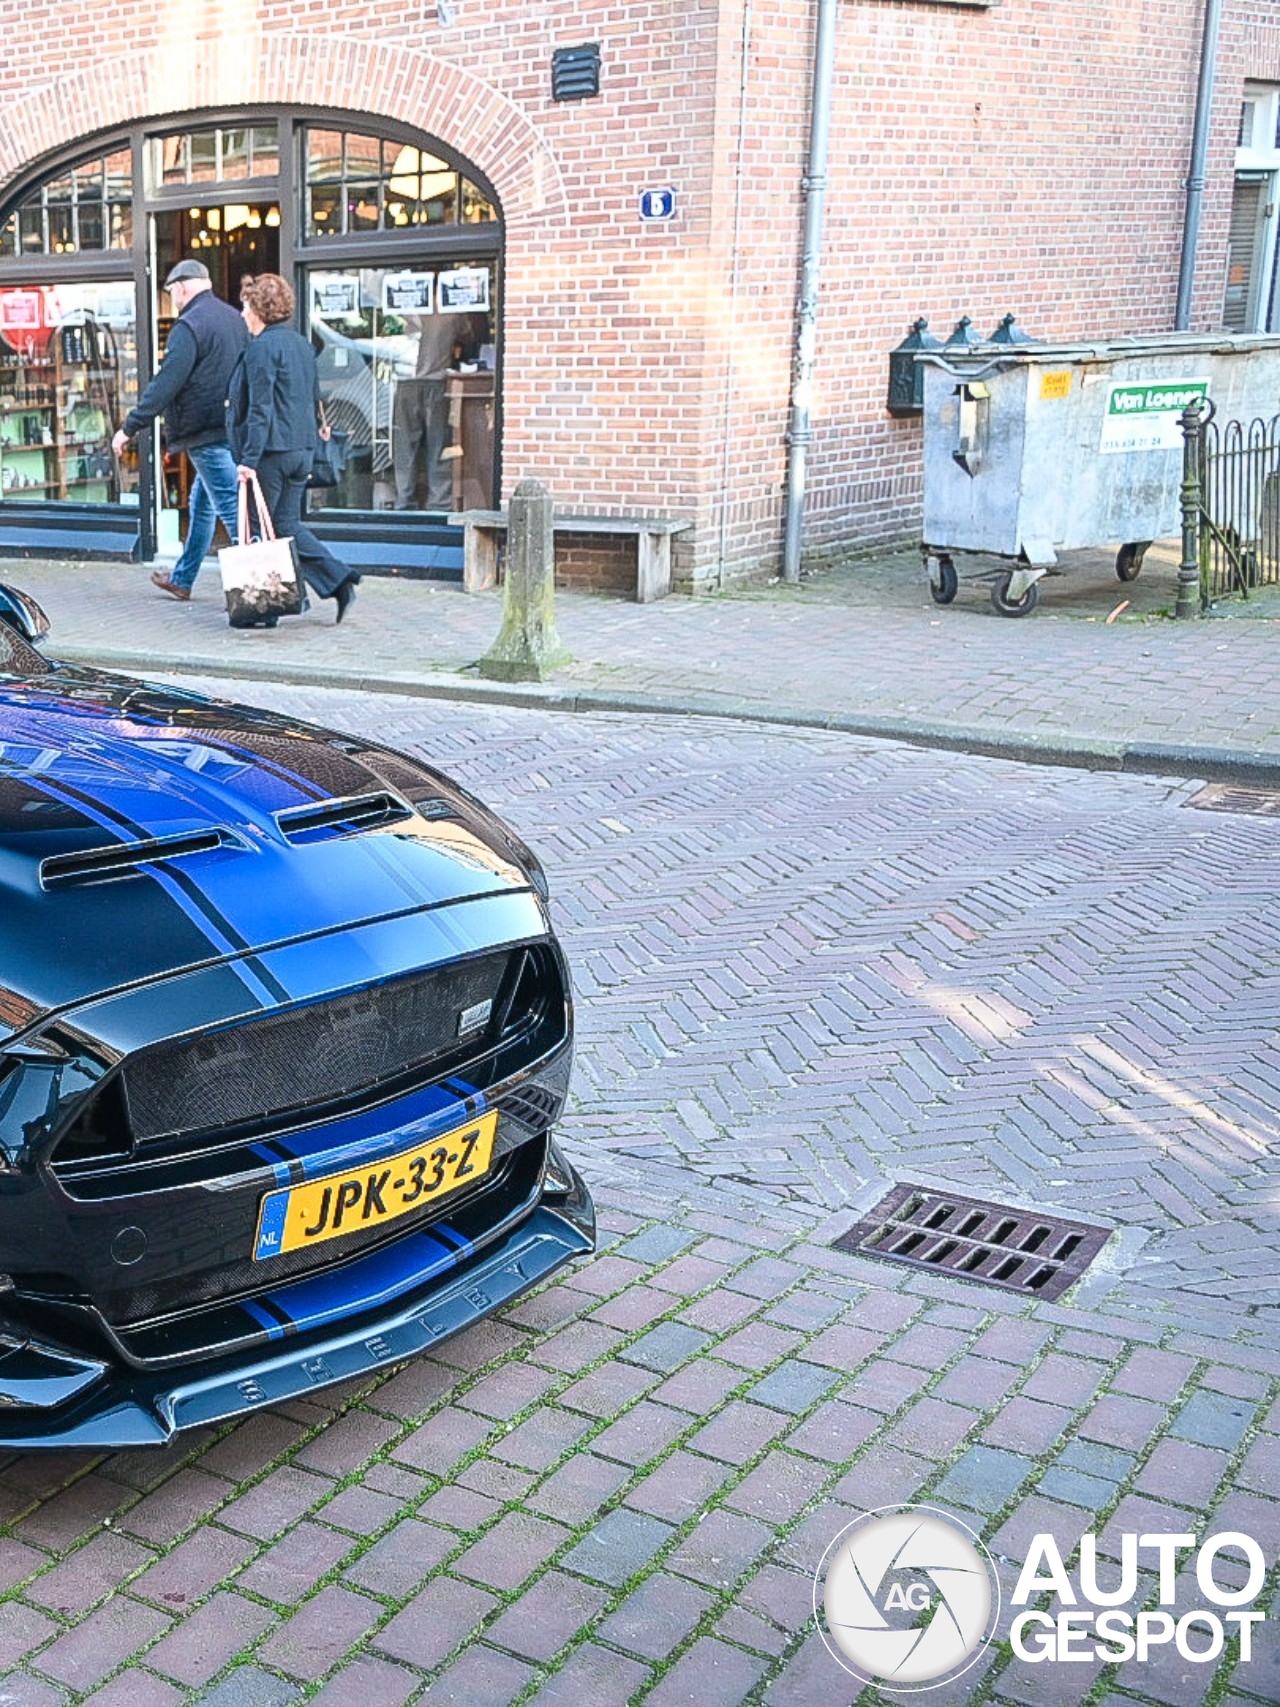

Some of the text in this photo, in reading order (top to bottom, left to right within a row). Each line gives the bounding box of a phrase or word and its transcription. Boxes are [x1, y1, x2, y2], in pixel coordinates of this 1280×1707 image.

[650, 192, 665, 216] 5
[1113, 392, 1143, 410] Van
[304, 1129, 481, 1237] JPK-33-Z
[259, 1230, 279, 1248] NL
